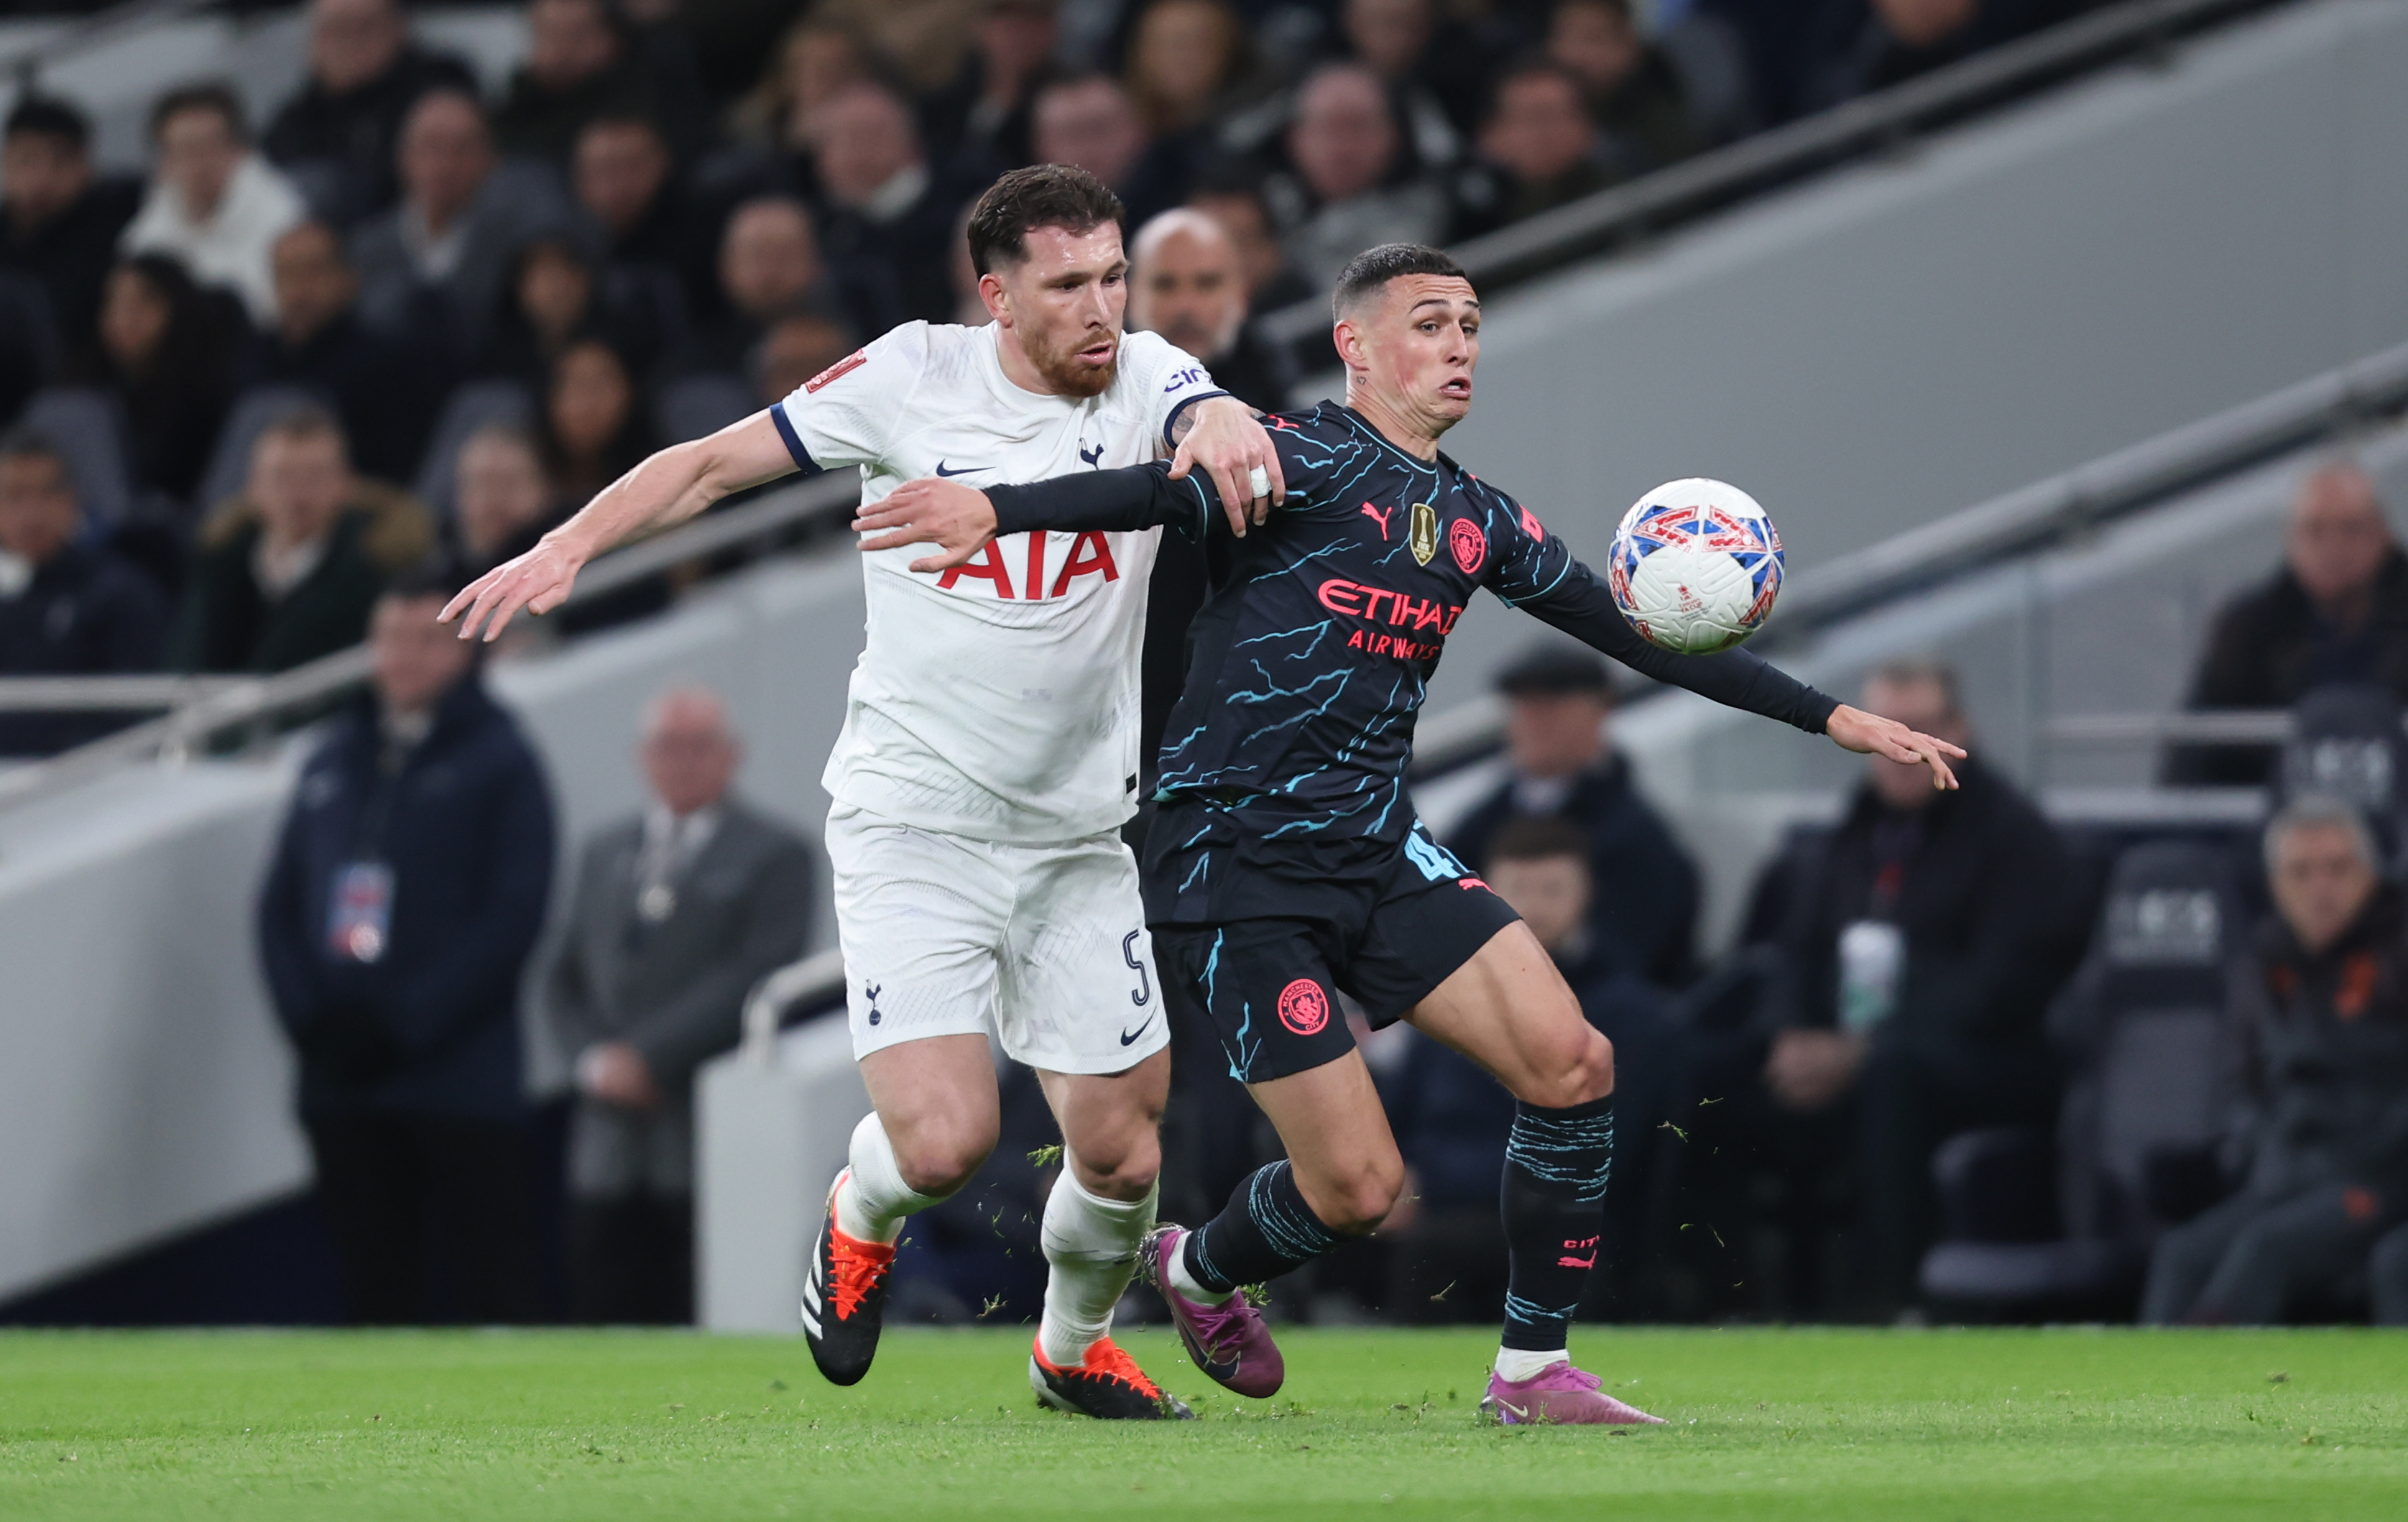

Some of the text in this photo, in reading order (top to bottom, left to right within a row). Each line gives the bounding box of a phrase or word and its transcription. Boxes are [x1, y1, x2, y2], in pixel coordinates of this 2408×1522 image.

[1163, 366, 1212, 392] cin
[936, 530, 1120, 599] AIA
[1347, 629, 1439, 660] AIRWAYS
[1404, 818, 1470, 881] 4
[1122, 928, 1150, 1007] 5
[1283, 982, 1319, 1007] MANCHESTER
[1305, 1020, 1320, 1030] CITY
